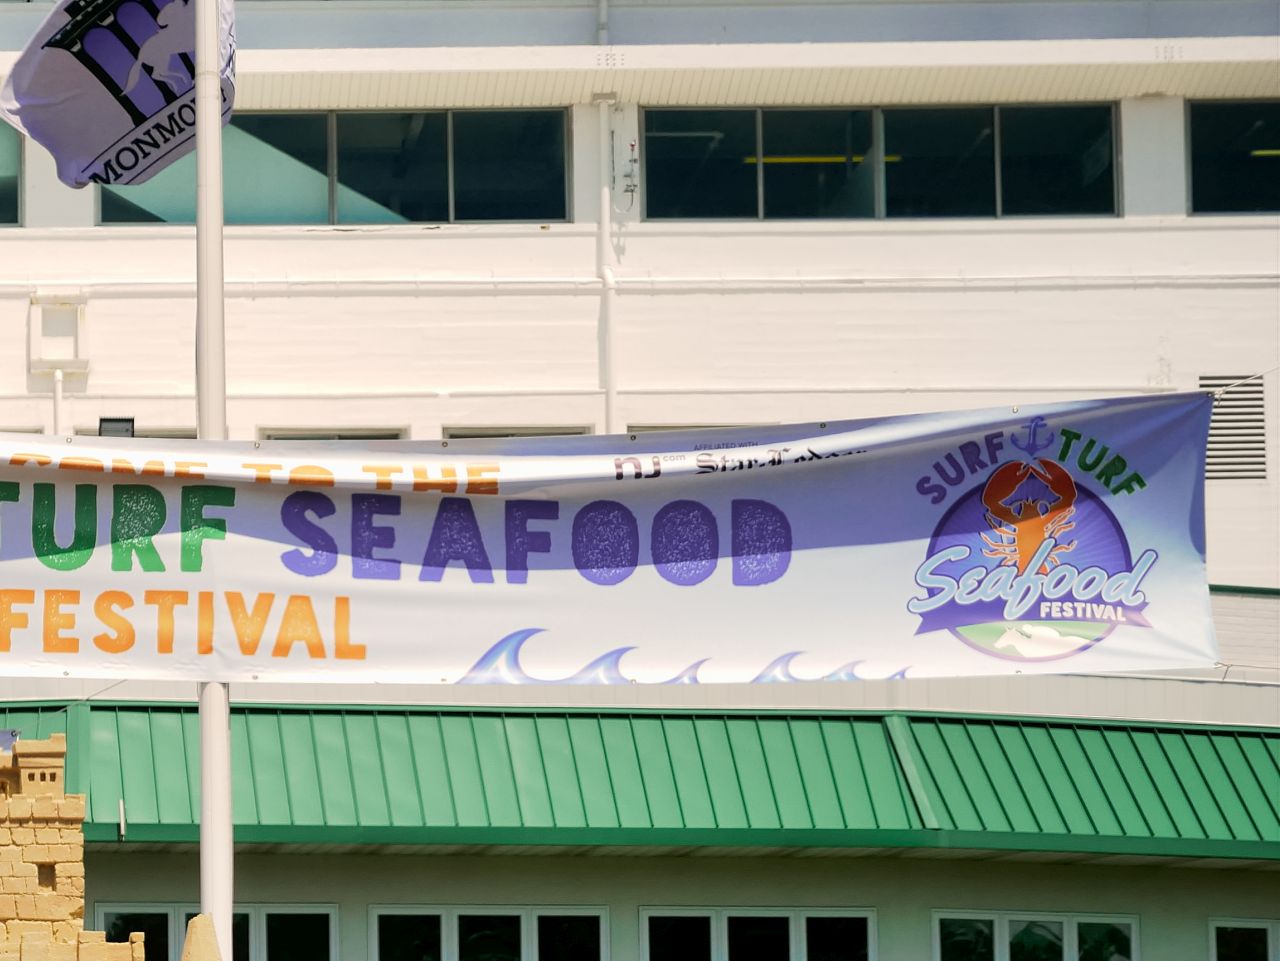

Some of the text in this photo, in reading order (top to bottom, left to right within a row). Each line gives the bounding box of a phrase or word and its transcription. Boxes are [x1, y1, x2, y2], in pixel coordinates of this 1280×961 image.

[89, 86, 227, 185] MONMO
[916, 428, 1147, 504] SURF TURF
[279, 490, 793, 587] SEAFOOD
[907, 538, 1158, 620] Seafood
[1040, 601, 1126, 622] FESTIVAL
